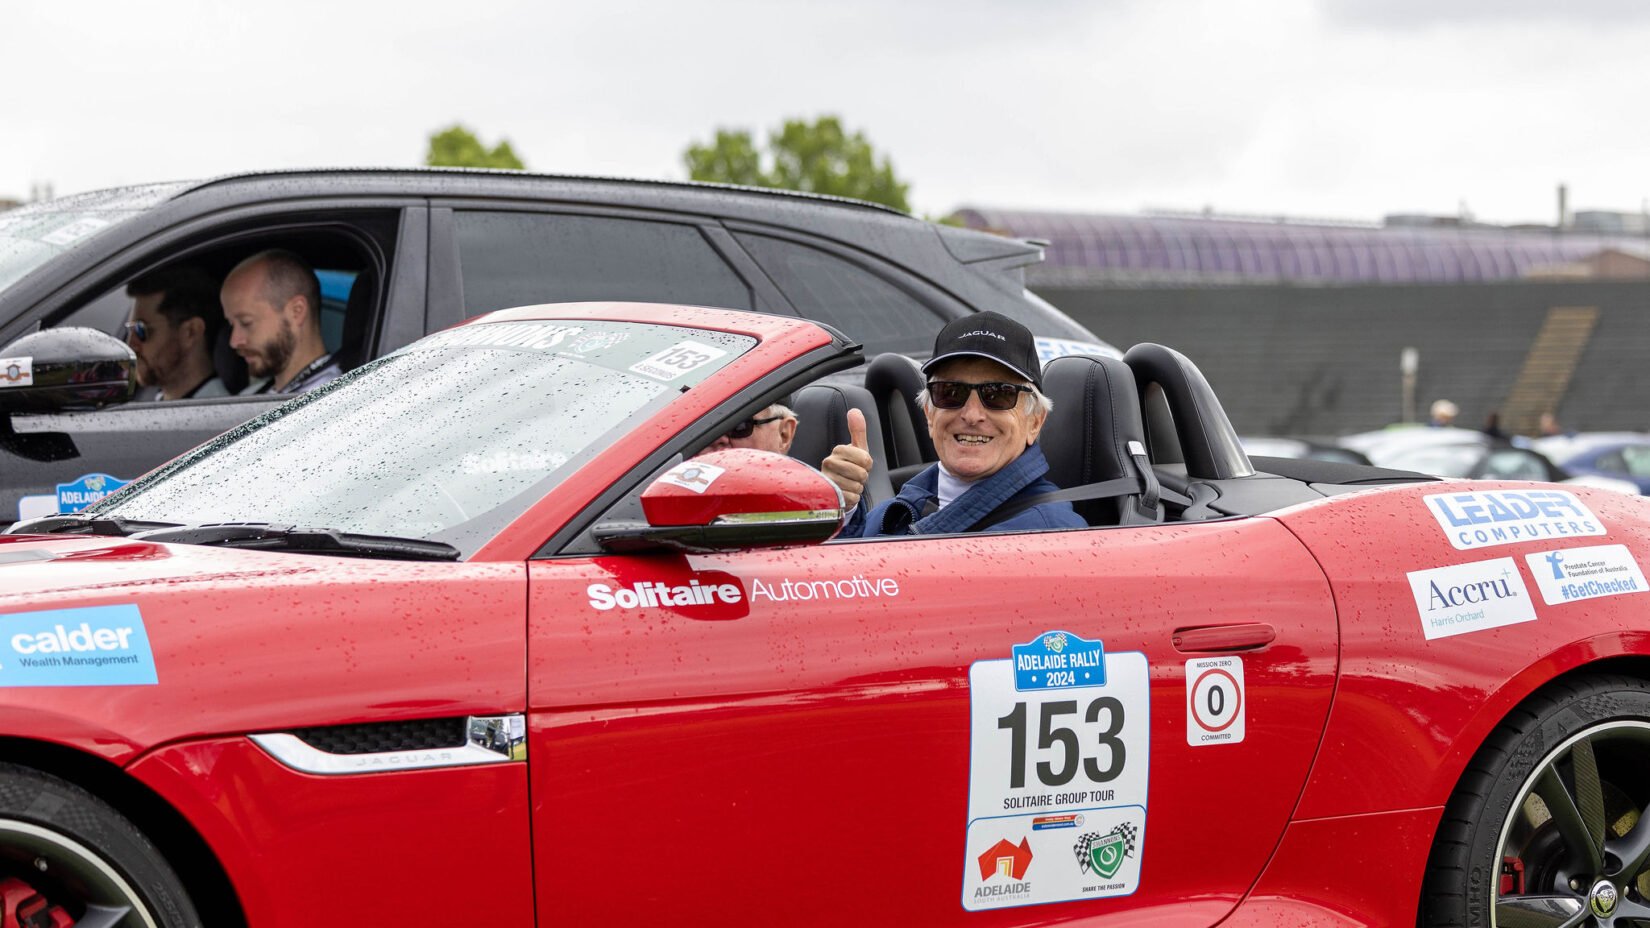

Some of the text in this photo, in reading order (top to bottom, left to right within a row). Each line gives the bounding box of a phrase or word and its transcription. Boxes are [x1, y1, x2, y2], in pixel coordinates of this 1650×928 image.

[957, 330, 1006, 341] JAGUAR
[655, 347, 711, 370] 153
[1433, 492, 1584, 527] LEADER
[1458, 520, 1596, 546] COMPUTERS
[1564, 560, 1606, 571] Prostate Cancer
[1568, 570, 1600, 578] Foundation
[586, 574, 899, 611] Solitaire Automotive
[1561, 576, 1638, 600] #GetChecked
[1430, 609, 1485, 627] Harris Orchard
[11, 622, 132, 654] calder
[20, 654, 139, 668] Wealth Management
[1018, 649, 1100, 671] ADELAIDE RALLY
[1046, 670, 1075, 687] 2024
[1207, 685, 1224, 716] 0
[998, 696, 1126, 789] 153
[1201, 733, 1231, 742] COMMITTED
[356, 752, 452, 766] JAGUAR
[1003, 789, 1115, 810] SOLITAIRE GROUP TOUR
[1092, 834, 1122, 847] SHANNONS
[974, 882, 1031, 898] ADELAIDE
[974, 892, 1030, 904] SOUTH AUSTRALIA
